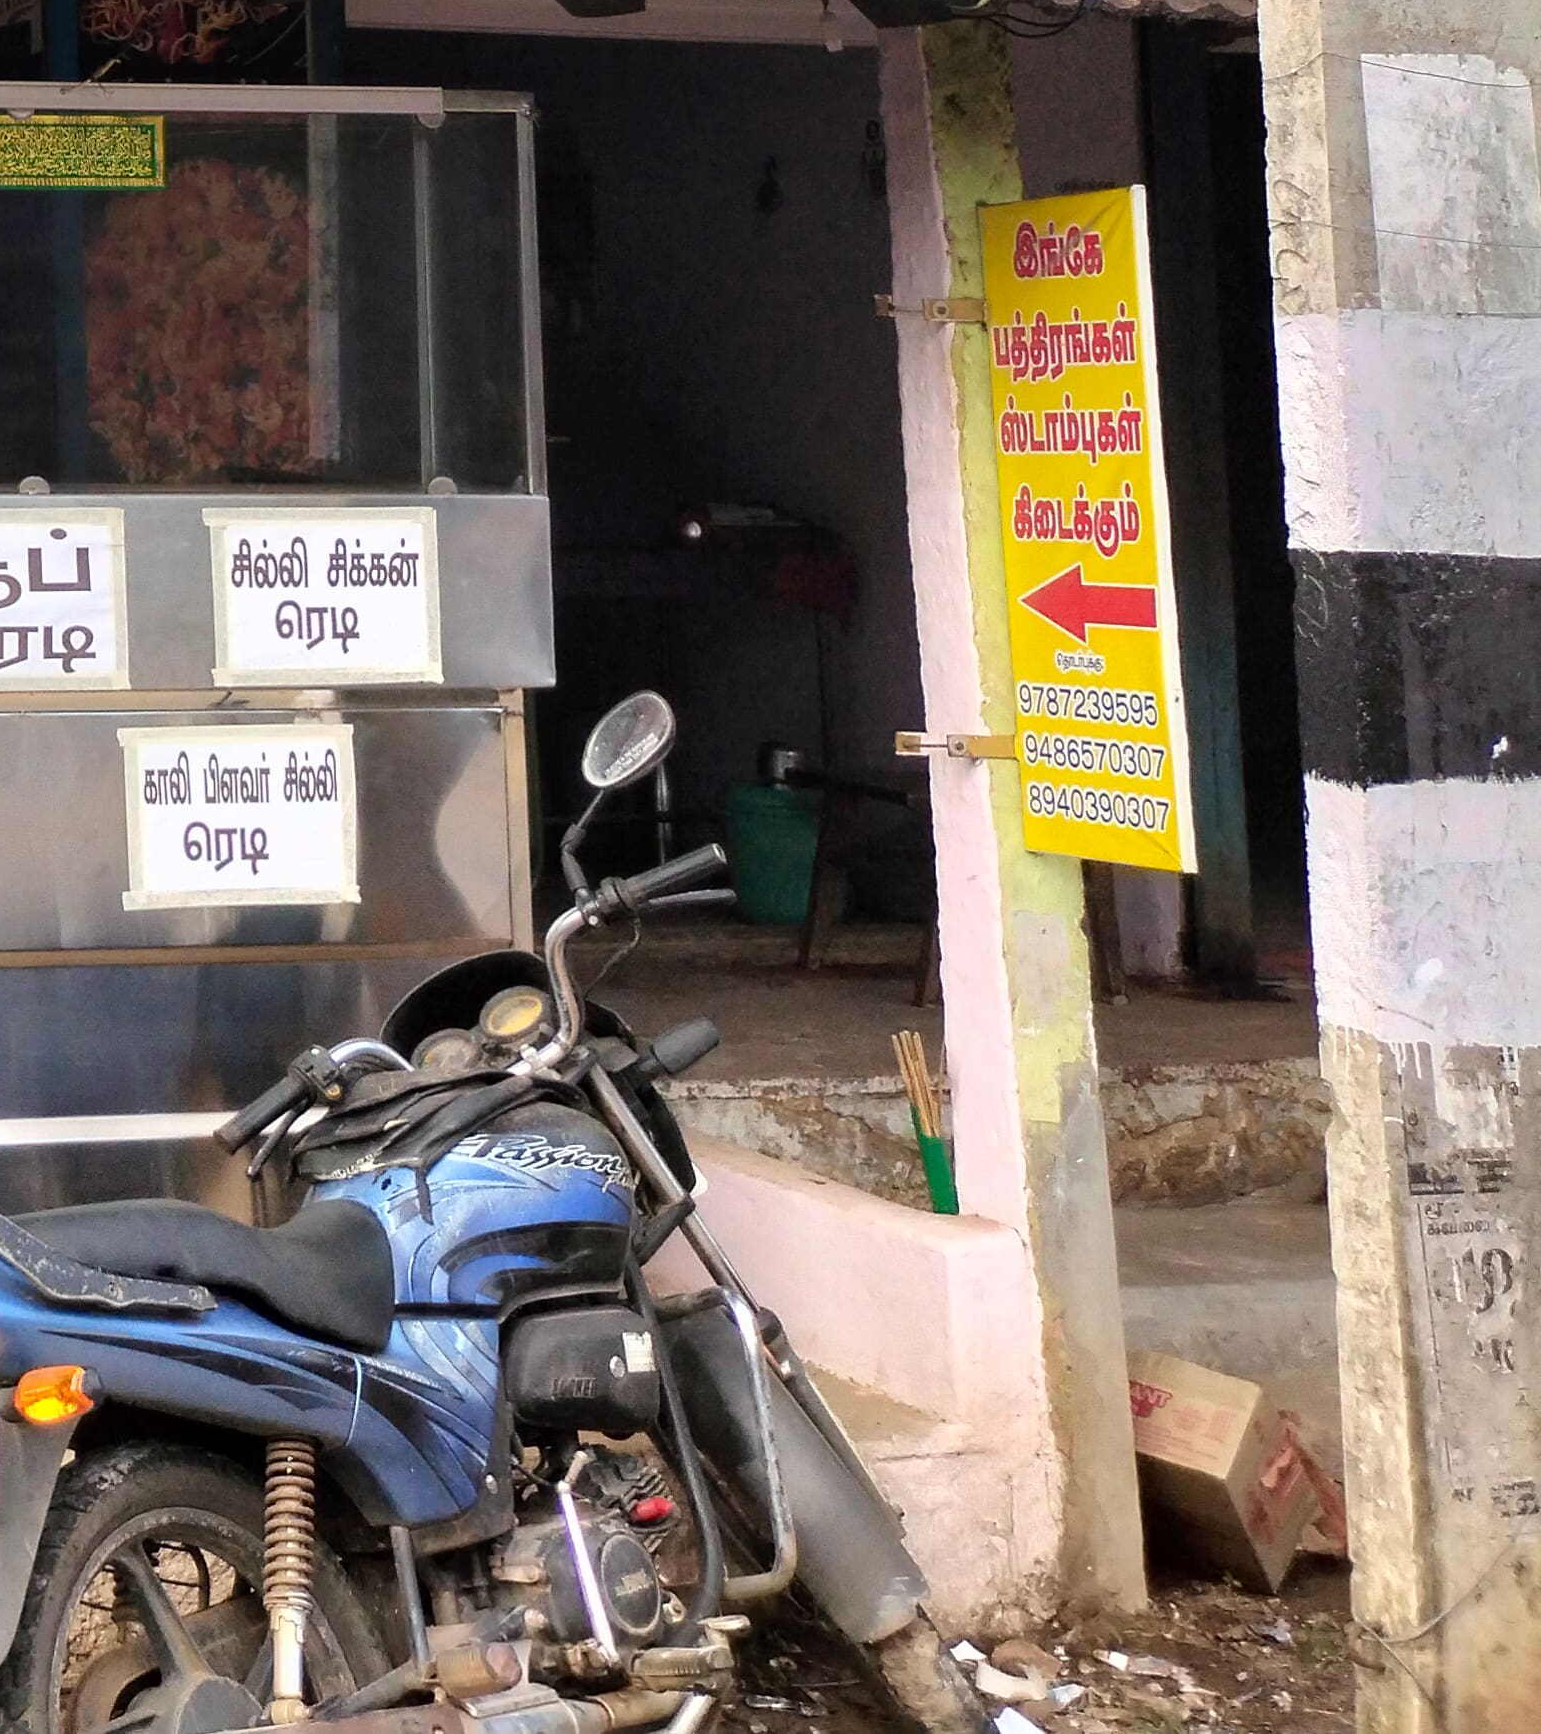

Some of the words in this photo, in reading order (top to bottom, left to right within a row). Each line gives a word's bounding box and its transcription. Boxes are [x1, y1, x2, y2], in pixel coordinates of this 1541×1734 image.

[1012, 219, 1105, 280] இங்கே
[993, 301, 1138, 384] பத்திரங்கள்
[1000, 392, 1143, 466] ஸ்டாம்புகள்
[1013, 479, 1141, 560] கிடைக்கும்
[231, 536, 310, 592] சில்லி
[327, 536, 420, 592] சிக்கன்
[274, 599, 361, 656] ரெடி
[1018, 683, 1158, 729] 9787239595
[144, 750, 192, 805] காலி
[203, 752, 271, 804] பிளவர்
[283, 748, 338, 803] சில்லி
[1025, 734, 1165, 780] 9486570307
[1029, 784, 1170, 834] 8940390307
[183, 820, 270, 876] ரெடி
[460, 1133, 625, 1174] Passion
